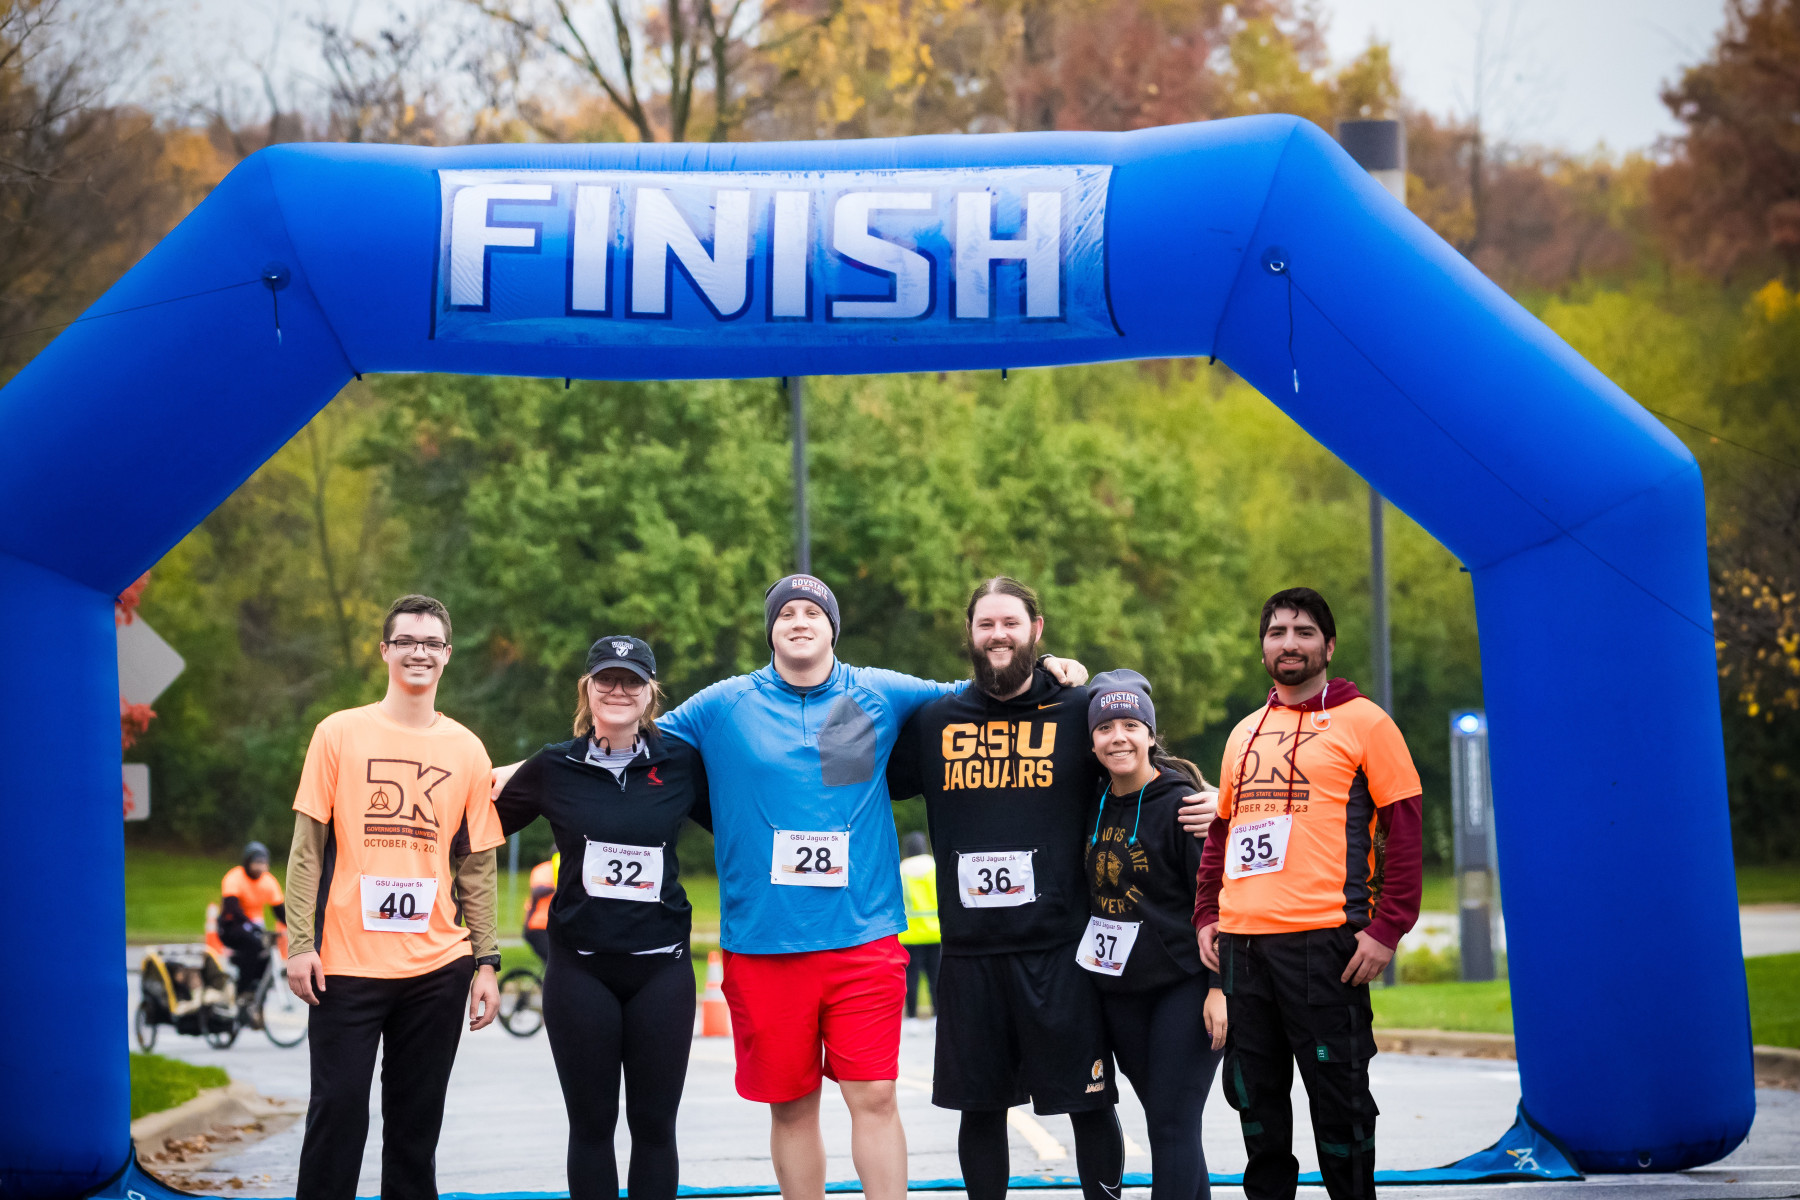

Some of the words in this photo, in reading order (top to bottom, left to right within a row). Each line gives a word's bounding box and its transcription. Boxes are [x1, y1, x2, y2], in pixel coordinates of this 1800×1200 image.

[450, 184, 1065, 321] FINISH
[792, 579, 828, 596] GOVSTATE
[1100, 692, 1140, 707] GOVSTATE
[942, 721, 1057, 760] GSU
[943, 759, 1053, 791] JAGUARS
[364, 758, 452, 828] 5K
[1264, 803, 1279, 813] 29,
[1282, 804, 1308, 813] 2023
[1248, 822, 1267, 832] Jaguar
[363, 838, 407, 849] OCTOBER
[424, 843, 437, 854] 20
[602, 846, 618, 854] GSU
[619, 848, 642, 856] Jaguar
[795, 846, 831, 873] 28
[986, 855, 1007, 863] Jaguar
[1240, 833, 1273, 863] 35
[605, 859, 643, 887] 32
[977, 867, 1011, 894] 36
[379, 892, 416, 919] 40
[1095, 933, 1118, 961] 37
